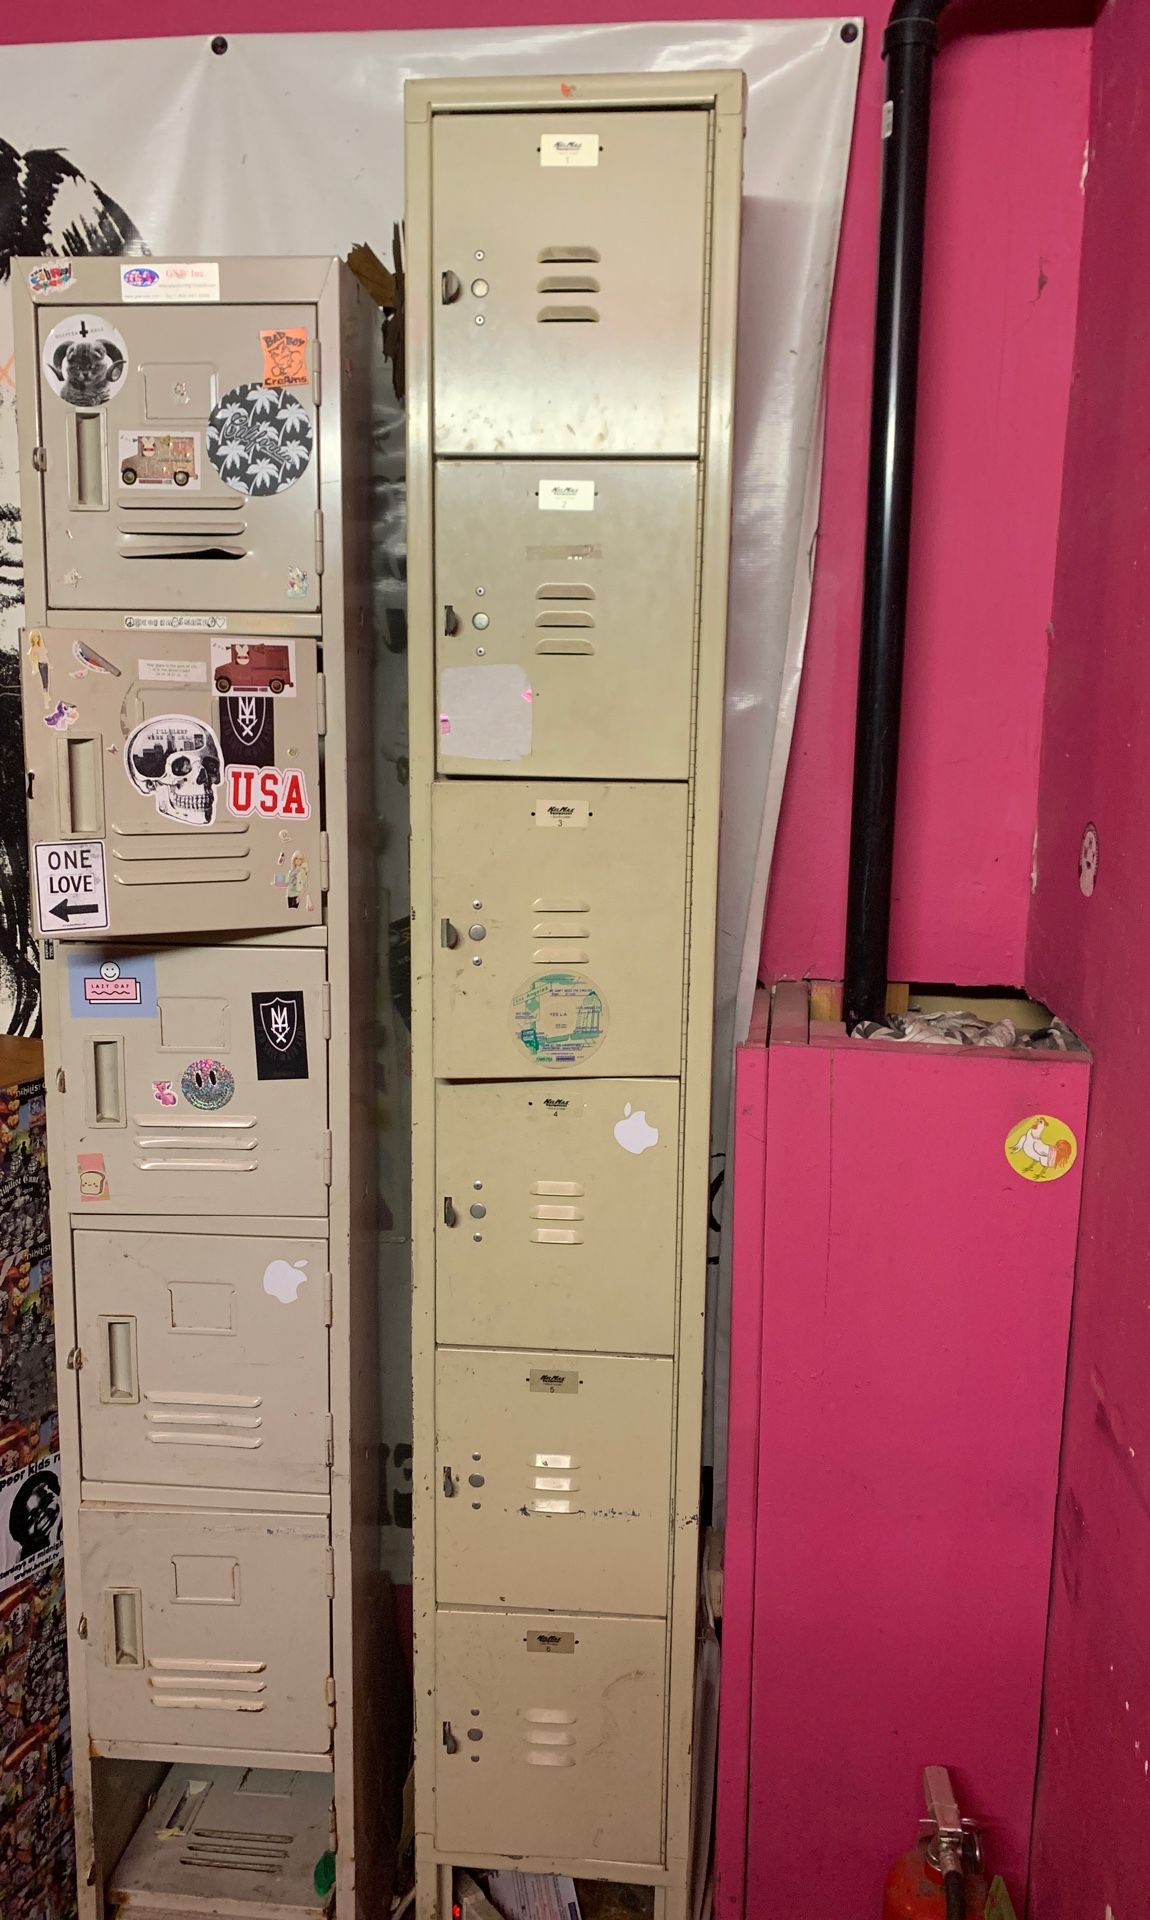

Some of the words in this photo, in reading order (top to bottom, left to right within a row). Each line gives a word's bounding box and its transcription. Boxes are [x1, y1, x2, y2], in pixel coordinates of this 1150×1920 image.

[262, 331, 286, 348] BAD
[224, 412, 294, 465] California
[231, 771, 305, 814] USA
[557, 819, 563, 827] 3
[48, 850, 92, 870] ONE
[49, 875, 93, 894] LOVE
[0, 1470, 26, 1493] poor
[27, 1456, 51, 1476] kids
[37, 1540, 64, 1559] midnigh
